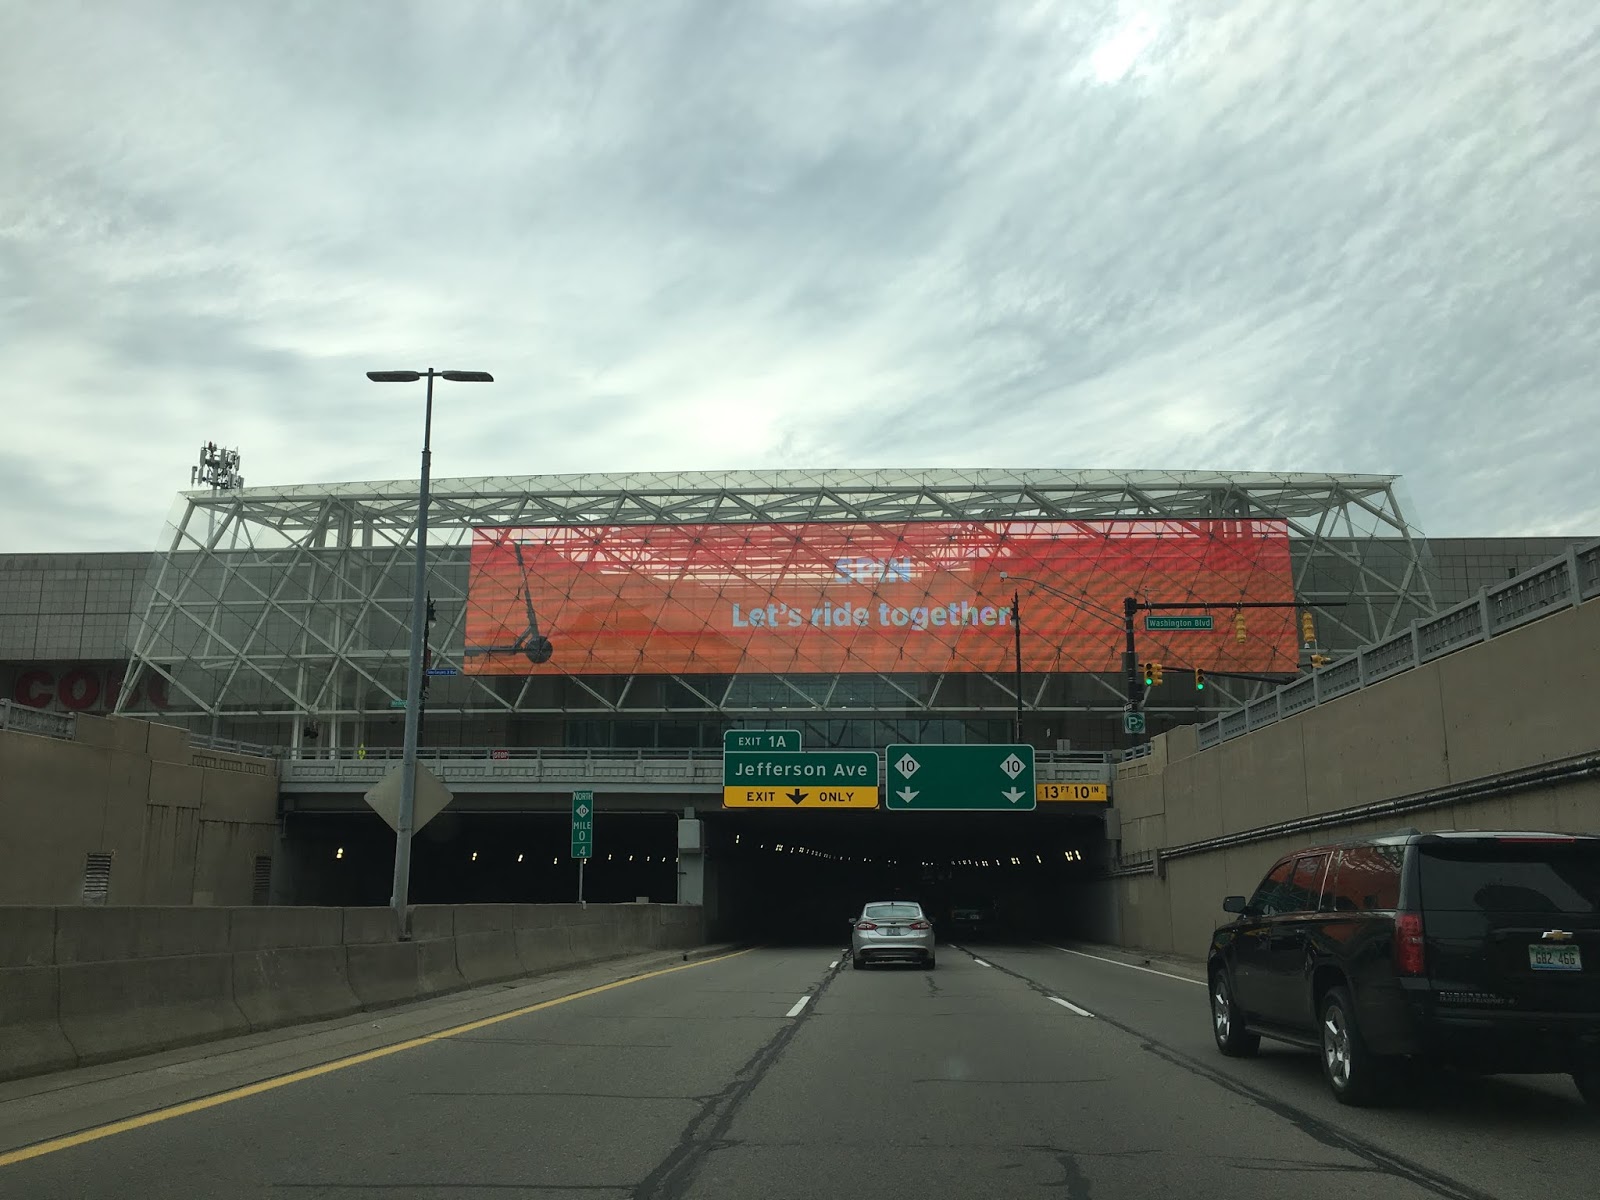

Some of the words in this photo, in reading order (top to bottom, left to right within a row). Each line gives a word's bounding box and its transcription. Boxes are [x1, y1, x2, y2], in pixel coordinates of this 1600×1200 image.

[835, 557, 911, 584] SPIN
[732, 603, 801, 627] Let's
[811, 602, 869, 627] ride
[1150, 619, 1192, 629] Washington
[1194, 619, 1211, 627] Blvd
[738, 737, 761, 746] EXIT
[768, 735, 786, 748] 1A
[494, 751, 508, 759] STOP
[735, 762, 826, 776] Jefferson
[833, 763, 867, 776] Ave
[901, 760, 915, 772] 10
[1006, 760, 1020, 772] 10
[572, 791, 593, 801] NORTH
[746, 791, 775, 802] EXIT
[819, 791, 855, 802] ONLY
[1044, 786, 1059, 799] 13
[1074, 786, 1090, 799] 10
[579, 807, 587, 815] 10
[573, 821, 591, 830] MILE
[578, 830, 586, 841] 0
